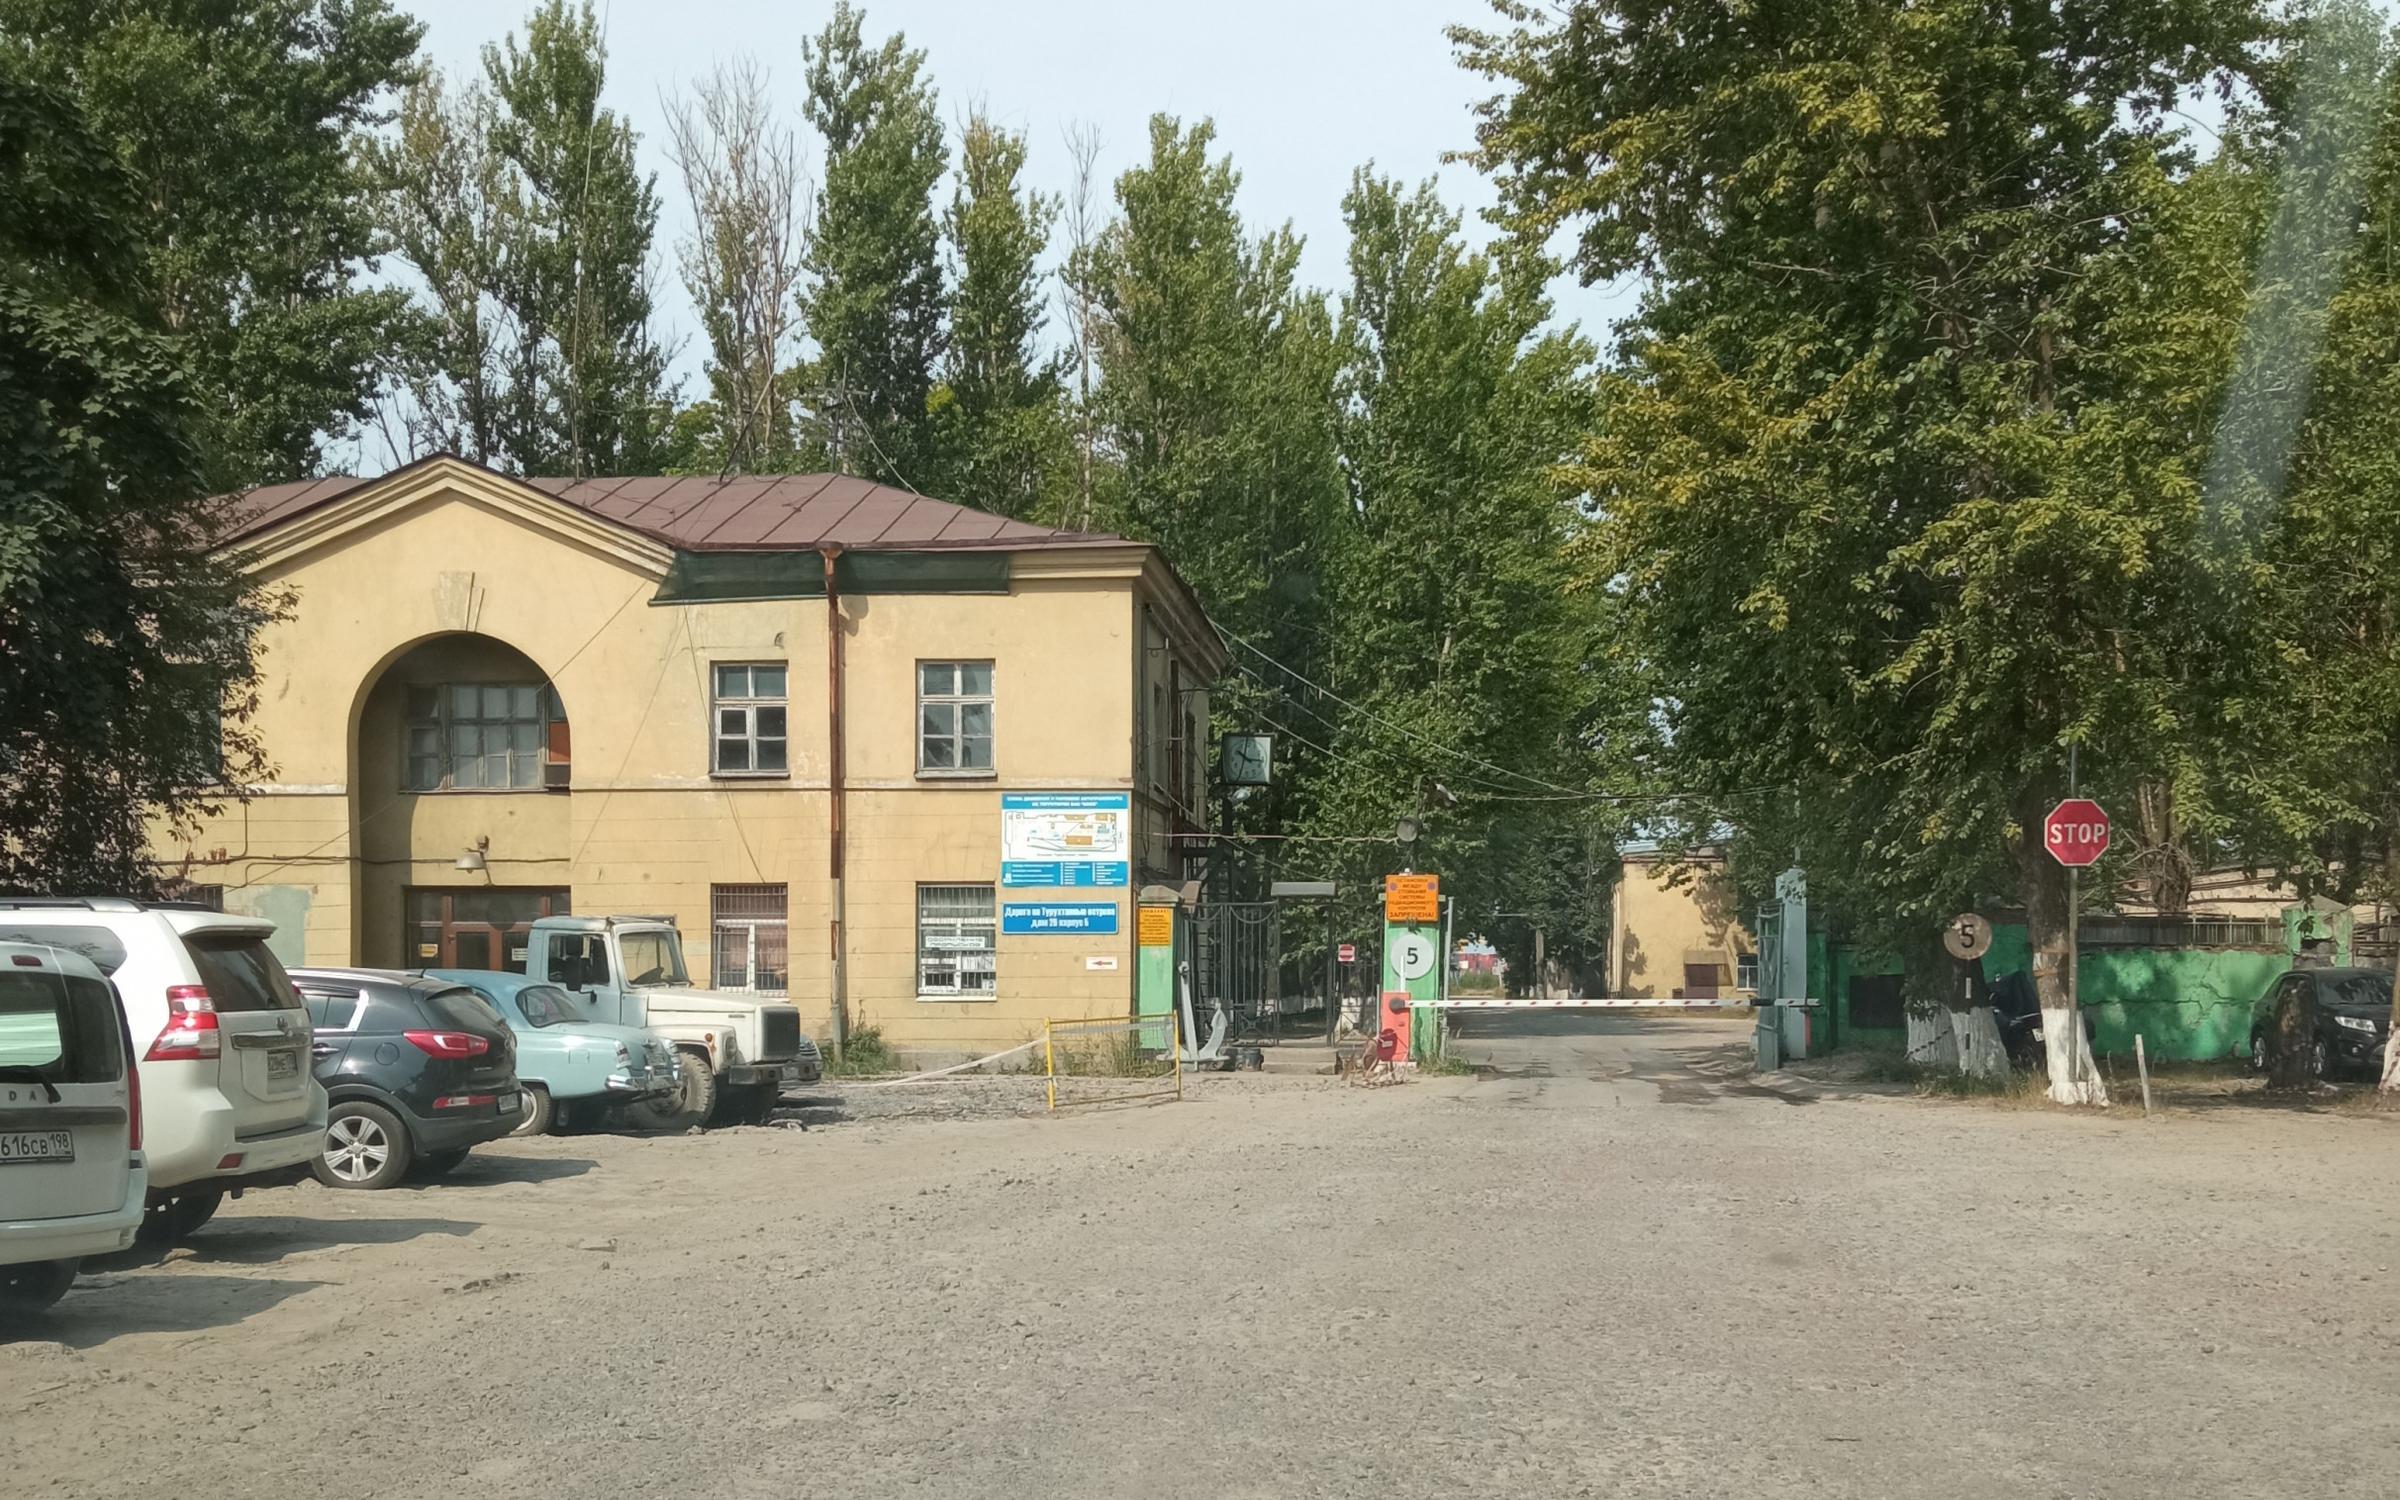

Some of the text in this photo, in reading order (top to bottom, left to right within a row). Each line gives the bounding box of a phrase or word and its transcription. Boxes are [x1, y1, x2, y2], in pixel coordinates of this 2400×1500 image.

[2050, 823, 2106, 844] STOP
[1004, 906, 1031, 917] Дорога
[1032, 908, 1041, 916] на
[1030, 918, 1048, 928] дом
[1059, 919, 1083, 929] корпус
[1961, 924, 1975, 949] 5
[1406, 946, 1419, 965] 5
[50, 1133, 70, 1149] 198
